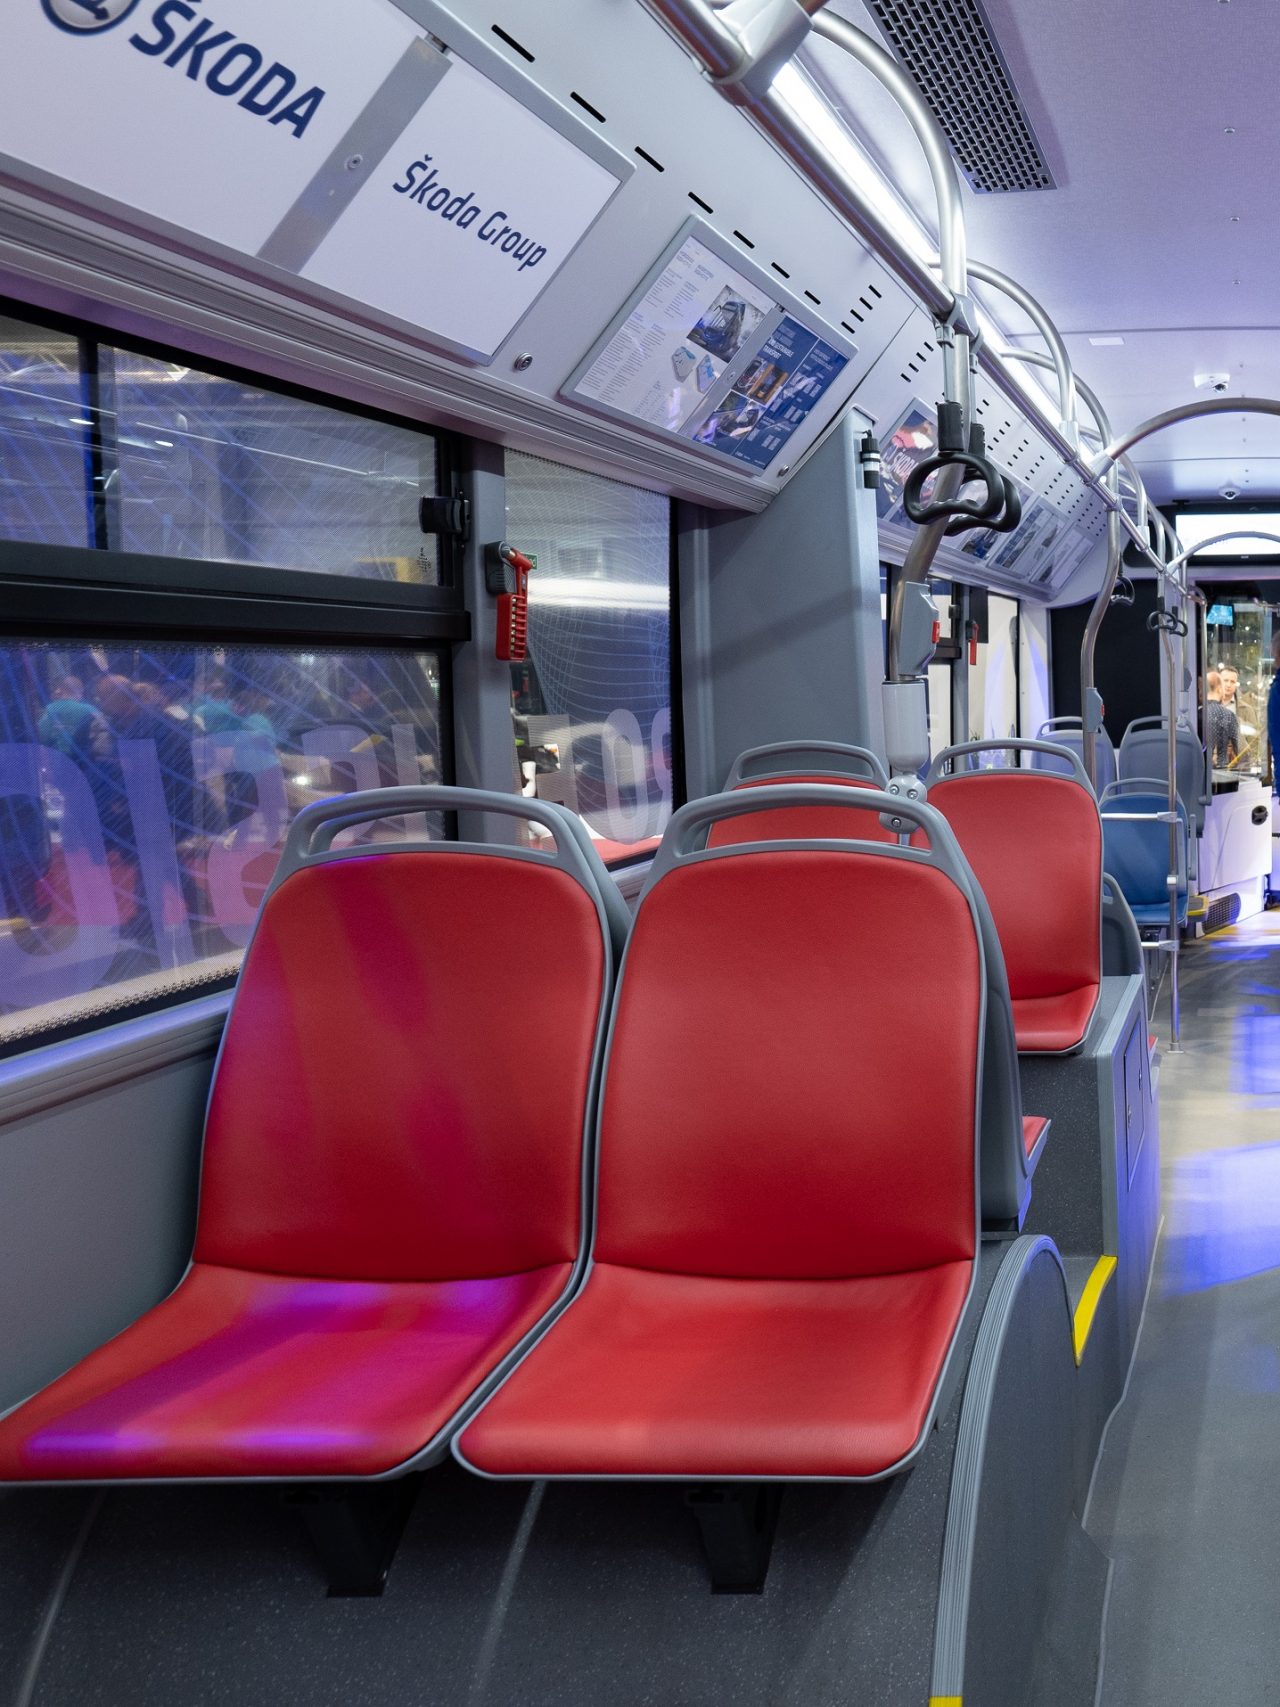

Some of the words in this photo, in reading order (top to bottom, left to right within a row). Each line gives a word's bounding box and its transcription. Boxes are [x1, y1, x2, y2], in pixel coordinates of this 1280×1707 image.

[129, 0, 326, 139] ŠKODA
[392, 155, 481, 230] Škoda
[477, 211, 547, 272] Group
